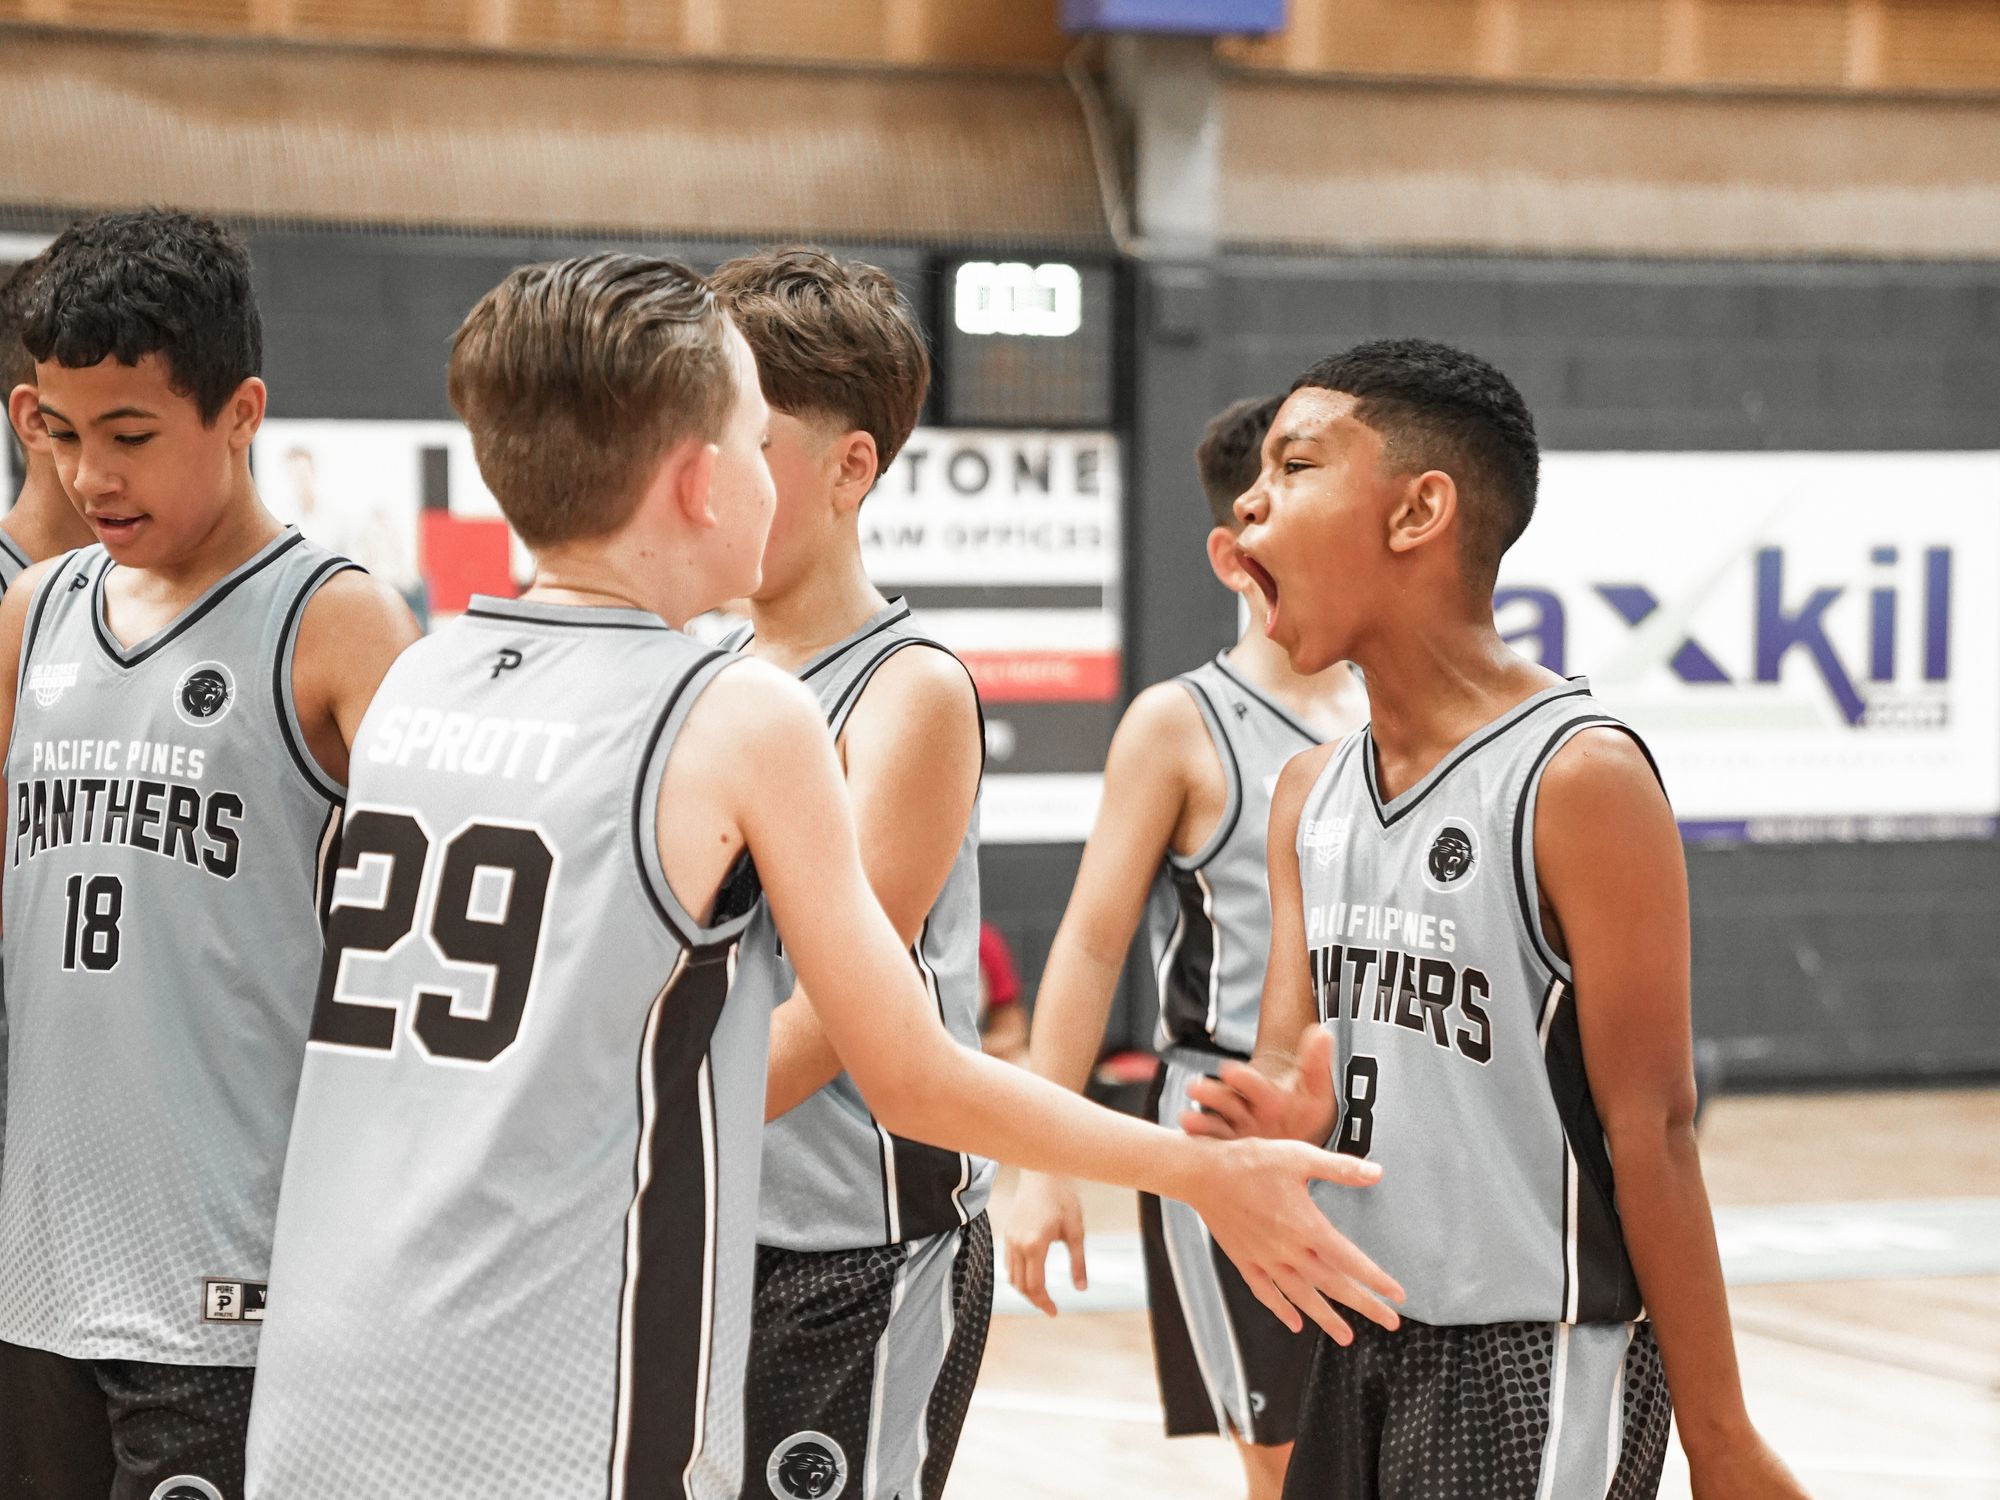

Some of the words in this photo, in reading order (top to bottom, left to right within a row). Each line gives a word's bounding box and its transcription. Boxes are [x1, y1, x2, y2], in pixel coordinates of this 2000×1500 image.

[33, 739, 121, 774] PACIFIC
[127, 741, 206, 779] PINES
[367, 705, 578, 783] SPROTT
[13, 776, 244, 881] PANTHERS
[62, 872, 124, 973] 18
[306, 803, 560, 1071] 29
[1336, 1053, 1379, 1160] 8
